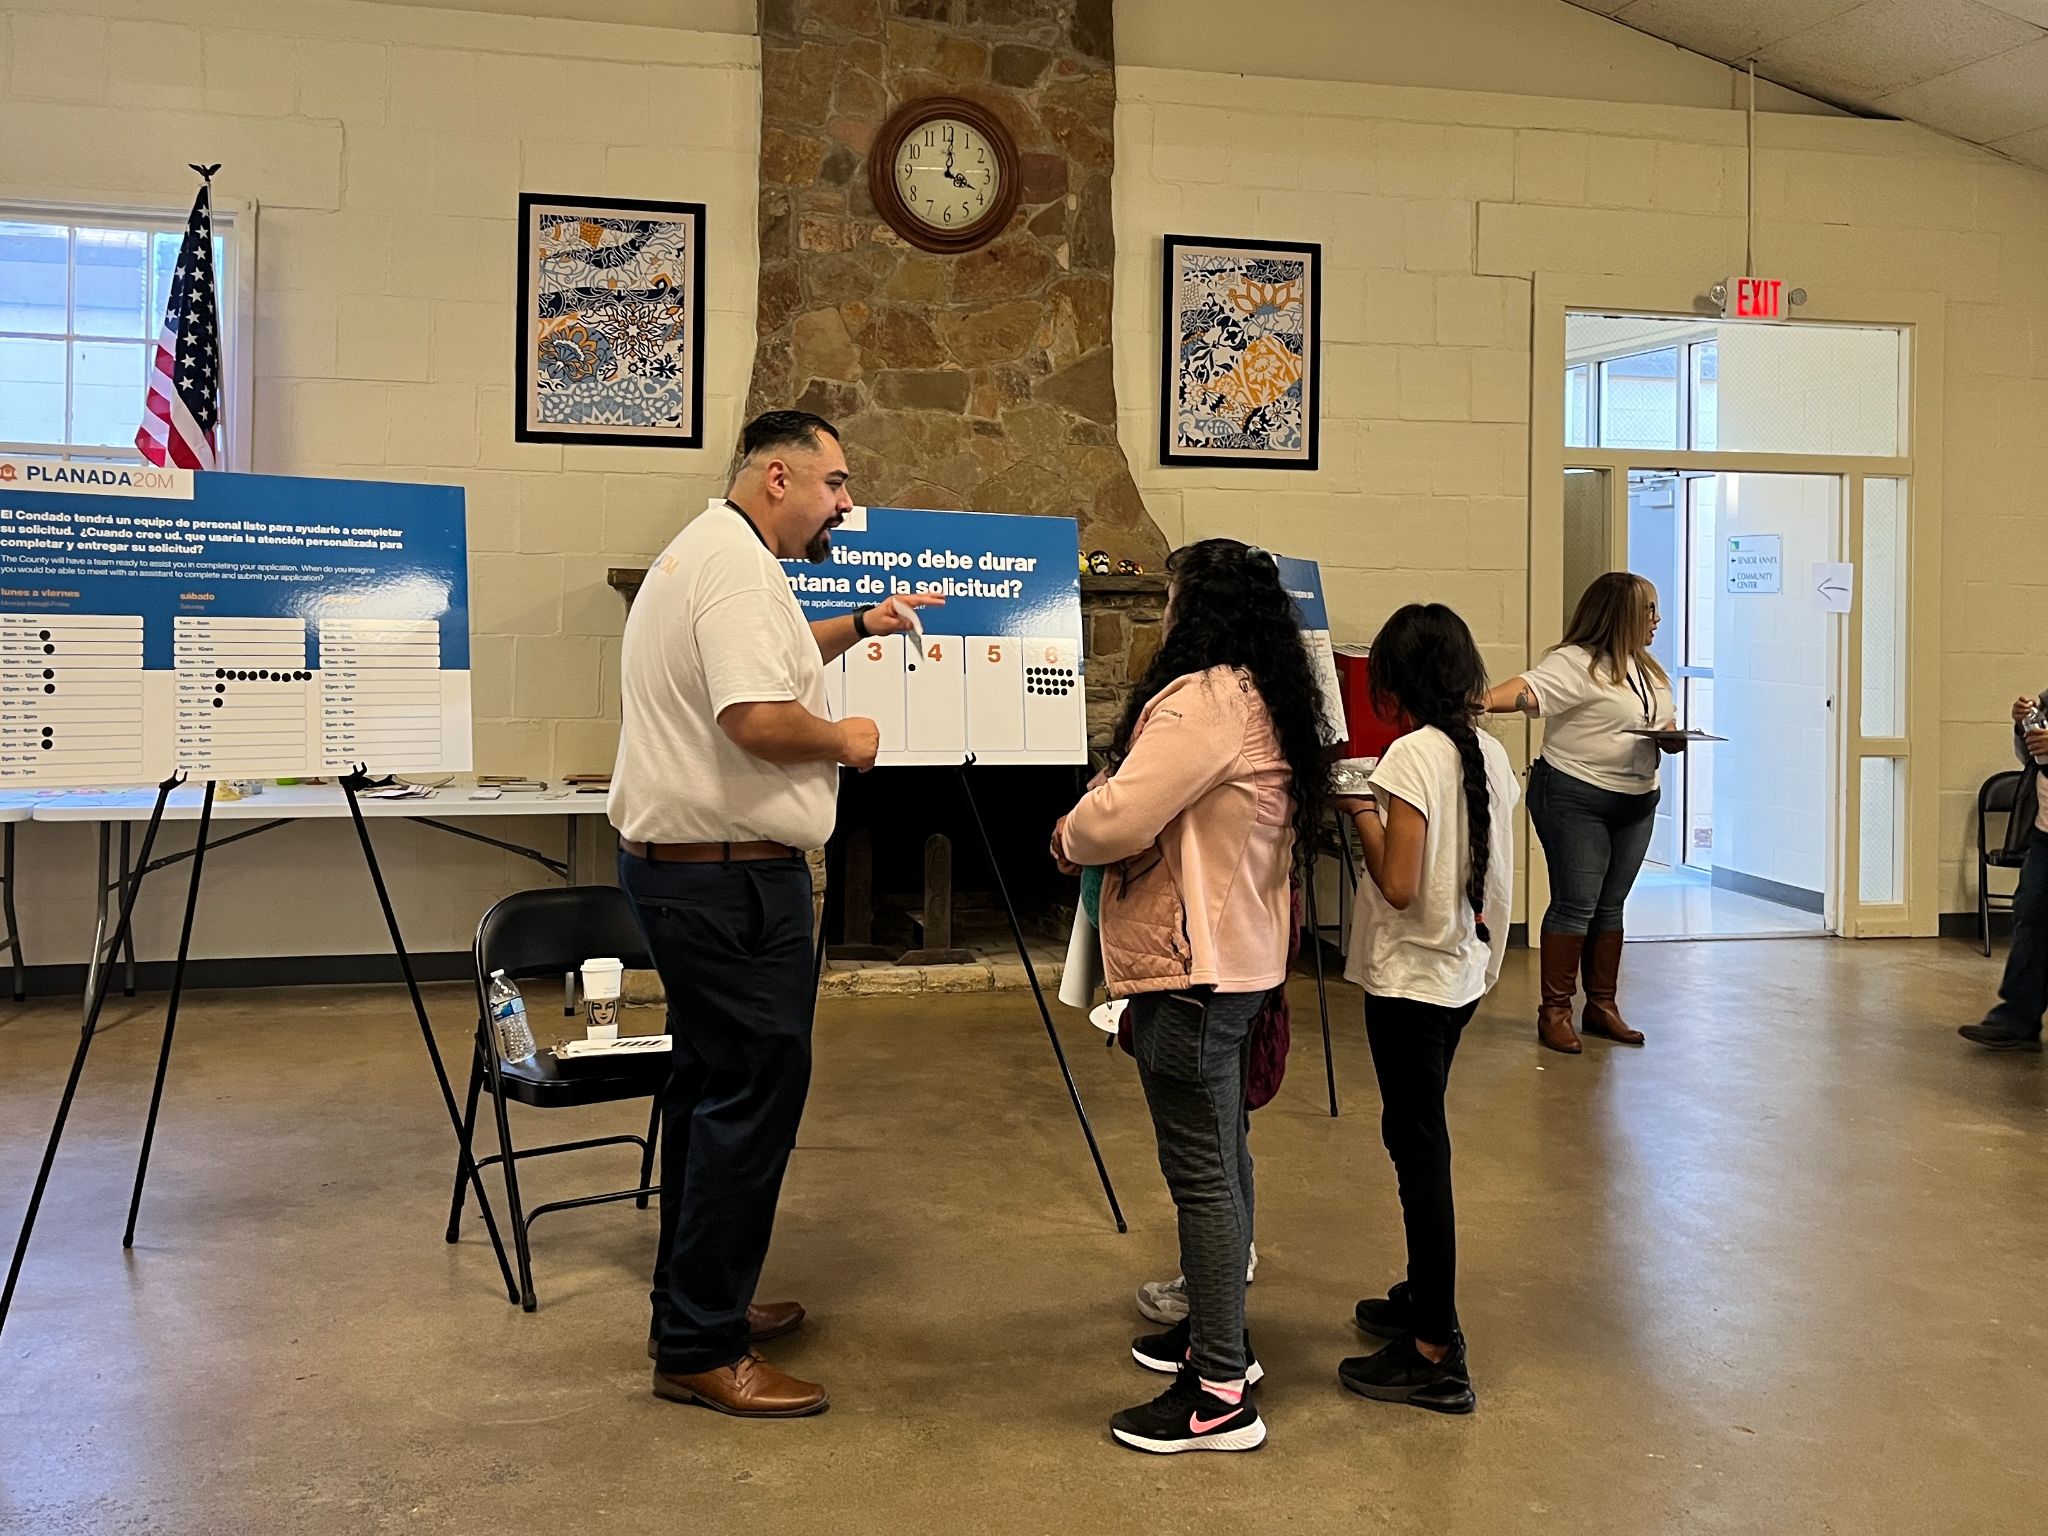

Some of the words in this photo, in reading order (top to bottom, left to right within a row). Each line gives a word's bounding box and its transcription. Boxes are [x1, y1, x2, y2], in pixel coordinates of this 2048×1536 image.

[925, 131, 934, 146] 11
[942, 126, 954, 142] 12
[965, 133, 969, 149] 1
[909, 144, 920, 160] 10
[978, 148, 985, 164] 2
[905, 164, 912, 180] 9
[984, 168, 990, 185] 3
[910, 185, 917, 202] 8
[976, 188, 984, 205] 4
[926, 200, 934, 216] 7
[943, 205, 951, 223] 6
[962, 202, 970, 218] 5
[1737, 278, 1781, 317] EXIT
[26, 465, 174, 489] PLANADA20M
[1, 509, 13, 519] El
[16, 510, 71, 522] Condado
[74, 513, 113, 524] tendrá
[116, 517, 131, 525] un
[133, 517, 173, 528] equipo
[175, 518, 191, 528] de
[192, 519, 241, 531] personal
[243, 521, 266, 531] listo
[268, 524, 293, 533] para
[295, 524, 340, 535] ayudarle
[351, 527, 403, 537] completar
[18, 525, 75, 536] solicitud.
[80, 528, 133, 538] ¿Cuando
[136, 531, 161, 539] cree
[165, 531, 183, 540] ud.
[184, 533, 206, 542] que
[209, 534, 243, 543] usaría
[245, 534, 255, 543] la
[258, 536, 304, 545] atención
[306, 537, 378, 548] personalizada
[380, 541, 403, 550] para
[1, 539, 64, 550] completar
[66, 542, 74, 551] y
[77, 542, 129, 552] entregar
[148, 544, 204, 554] solicitud?
[1, 555, 17, 563] The
[19, 555, 49, 565] County
[51, 556, 64, 564] will
[65, 556, 86, 565] have
[94, 558, 114, 566] team
[116, 559, 138, 568] ready
[149, 560, 171, 568] assist
[173, 562, 187, 570] you
[196, 562, 238, 571] completing
[257, 564, 298, 572] application.
[831, 545, 912, 571] tiempo
[917, 549, 973, 570] debe
[978, 553, 1037, 573] durar
[18, 566, 43, 574] would
[184, 572, 220, 580] complete
[263, 574, 280, 582] your
[281, 573, 324, 582] application?
[1, 588, 29, 597] lunes
[41, 589, 80, 598] viernes
[785, 573, 850, 592] ntana
[855, 575, 884, 594] de
[891, 575, 911, 595] la
[916, 578, 1023, 598] solicitud?
[180, 592, 215, 600] sábado
[799, 599, 810, 607] he
[811, 600, 856, 608] application
[867, 642, 882, 660] 3
[928, 644, 943, 662] 4
[987, 645, 1001, 663] 5
[1044, 646, 1058, 664] 6
